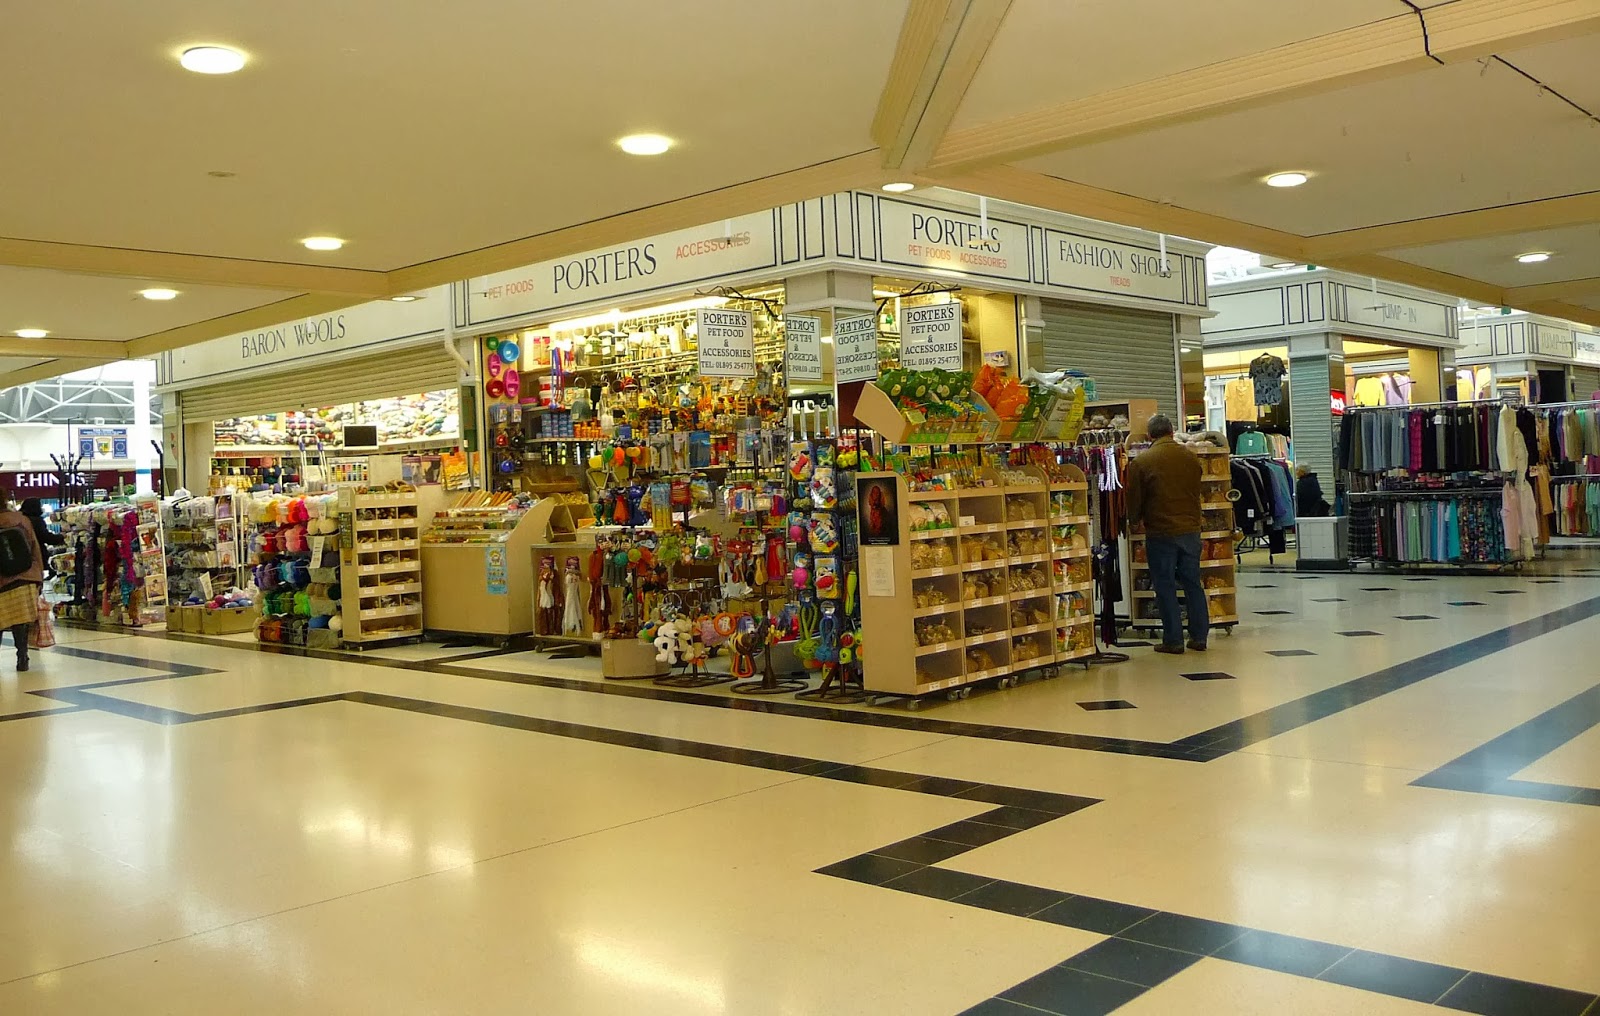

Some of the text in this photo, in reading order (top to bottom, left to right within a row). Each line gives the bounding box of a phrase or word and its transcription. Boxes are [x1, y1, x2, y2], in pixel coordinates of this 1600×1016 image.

[908, 244, 1007, 269] PET FOODS ACCESSORIES
[1059, 240, 1123, 270] FASHION
[553, 243, 657, 294] PORTERS
[488, 279, 534, 300] PET FOODS
[703, 312, 747, 326] PORTER'S
[906, 306, 954, 322] PORTER'S
[707, 327, 744, 338] PET FOOD
[911, 323, 951, 334] PET FOOD
[241, 314, 346, 359] BARON WOOLS
[723, 338, 729, 348] &
[927, 335, 933, 343] &
[702, 347, 752, 358] ACCESSORIES
[904, 342, 958, 355] ACCESSORIES
[903, 358, 917, 367] TEL:
[917, 357, 937, 366] 01895
